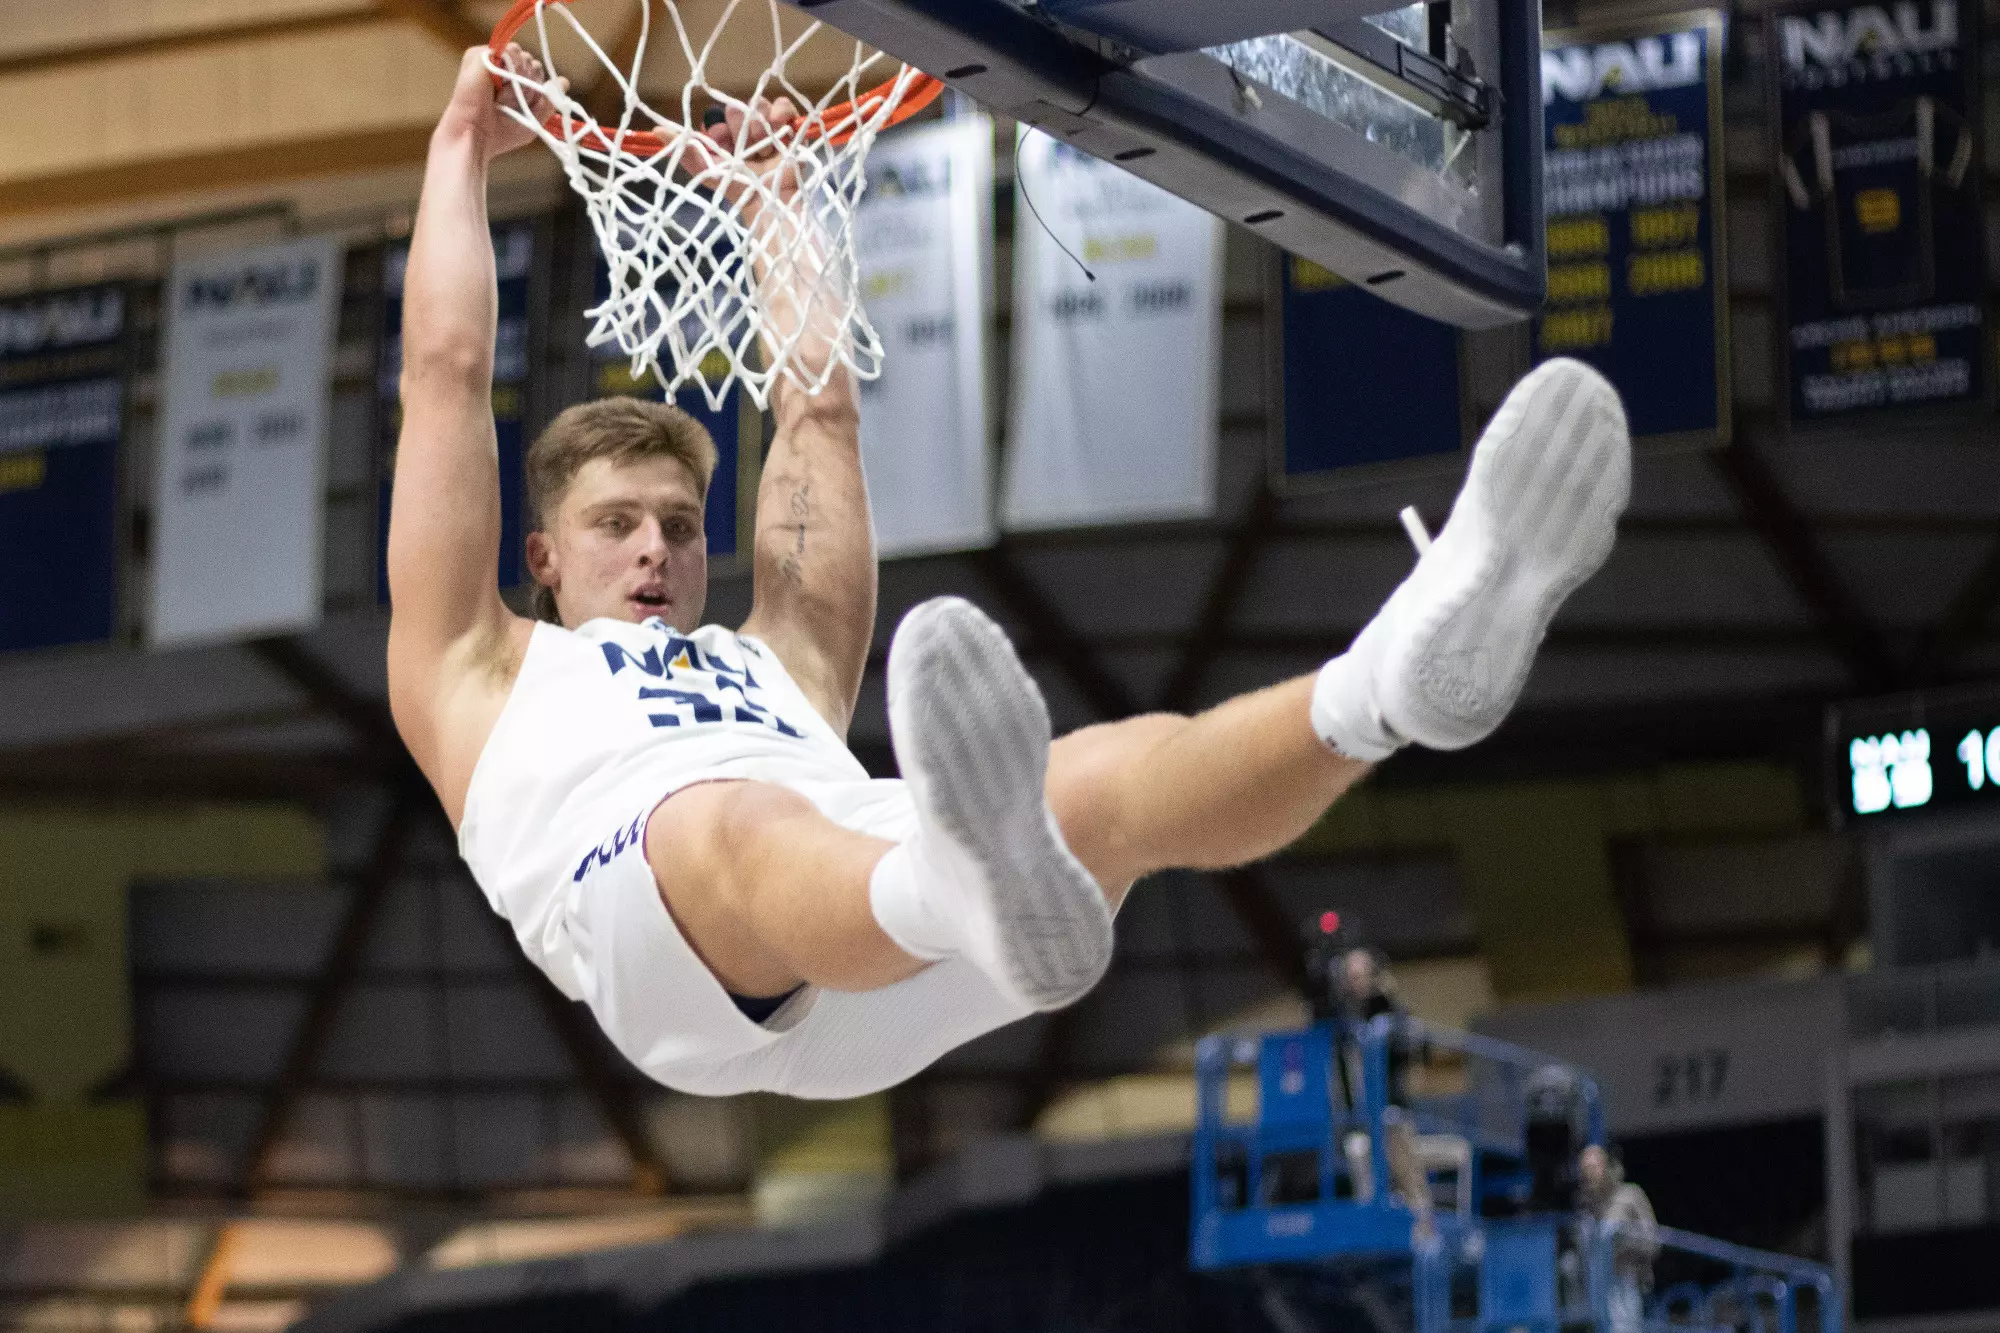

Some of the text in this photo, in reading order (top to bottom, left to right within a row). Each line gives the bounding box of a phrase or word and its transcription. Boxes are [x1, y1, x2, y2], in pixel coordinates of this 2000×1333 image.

[1541, 32, 1699, 104] NAU
[1783, 1, 1958, 71] NAU
[599, 636, 762, 690] NAU
[1655, 1048, 1731, 1107] 217
